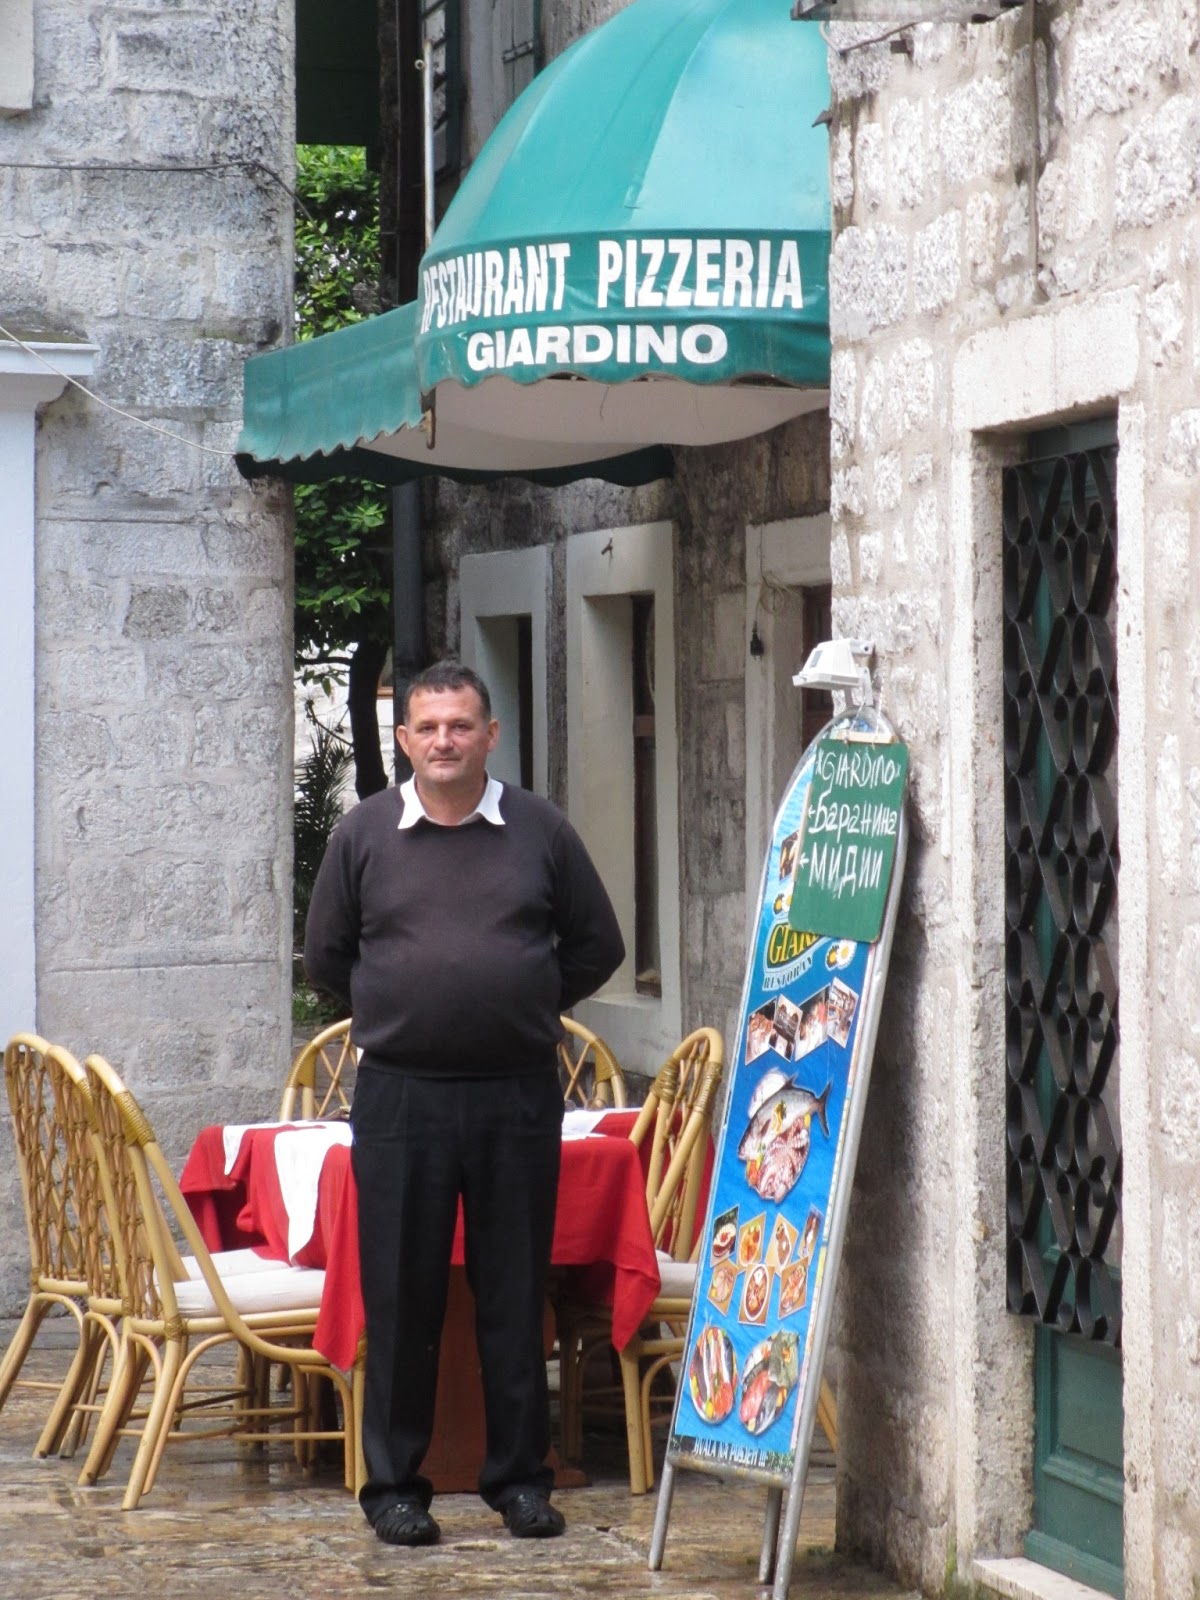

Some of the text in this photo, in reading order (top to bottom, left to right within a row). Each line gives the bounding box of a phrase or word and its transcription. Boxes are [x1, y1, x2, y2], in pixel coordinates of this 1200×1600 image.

[420, 238, 804, 334] RESTAURANT PIZZERIA
[466, 324, 728, 371] GIARDINO
